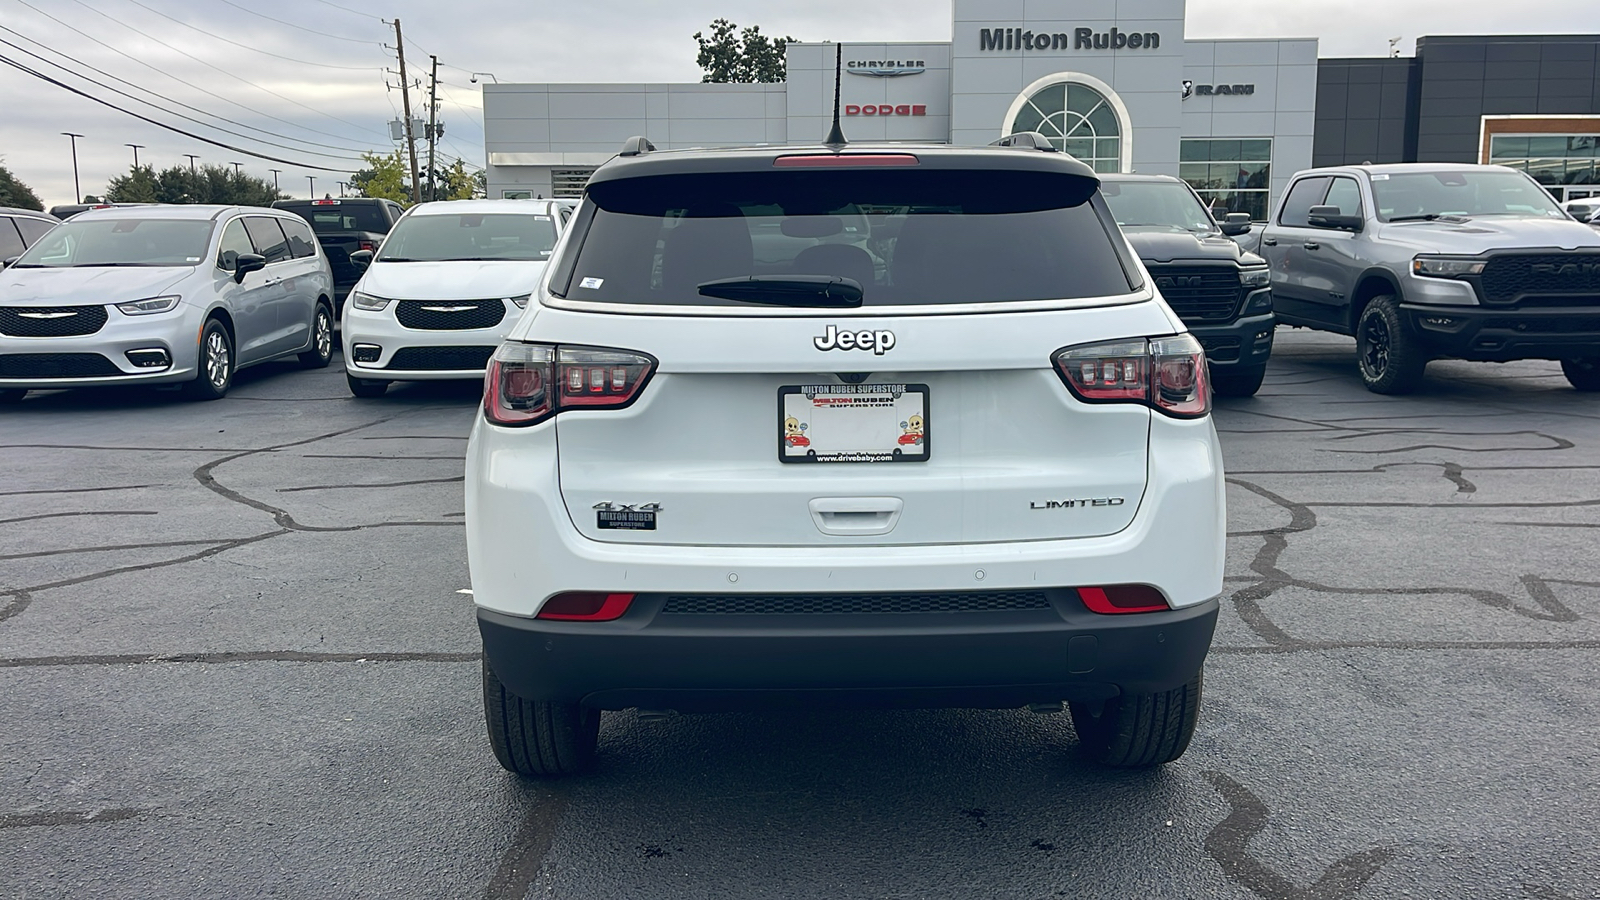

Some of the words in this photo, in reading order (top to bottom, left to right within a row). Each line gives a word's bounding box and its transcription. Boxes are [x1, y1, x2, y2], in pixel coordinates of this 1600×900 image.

[980, 28, 1068, 51] Milton
[1074, 27, 1160, 50] Ruben
[847, 60, 925, 68] CHRYSLER
[1195, 84, 1255, 96] RAM
[845, 104, 927, 116] DODGE
[1154, 276, 1202, 287] AM
[813, 324, 896, 356] Jeep
[801, 386, 830, 394] MILTON
[831, 385, 856, 394] RUBEN
[857, 384, 907, 393] SUPERSTORE
[1029, 498, 1125, 510] LIMITED
[600, 511, 628, 521] MILTON
[628, 512, 654, 522] RUBEN
